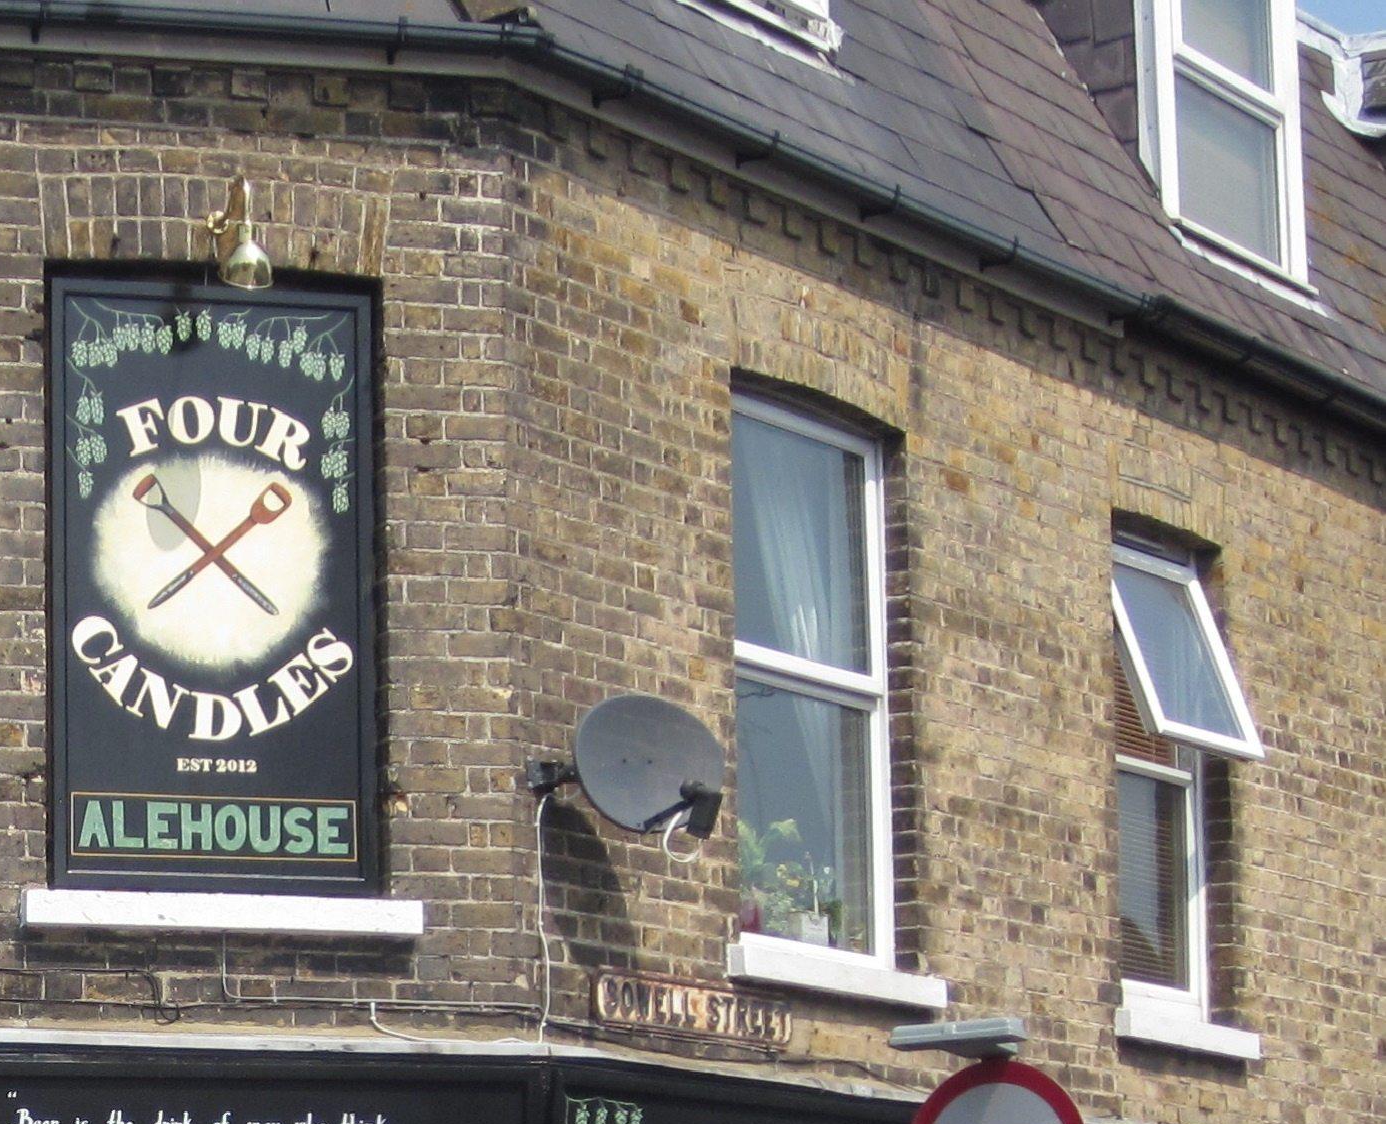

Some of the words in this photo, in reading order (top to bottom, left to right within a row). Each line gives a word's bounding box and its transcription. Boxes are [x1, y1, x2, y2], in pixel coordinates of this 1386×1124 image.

[115, 395, 310, 472] FOUR
[71, 614, 354, 742] CANDLES
[176, 757, 214, 773] EST
[215, 758, 258, 774] 2012
[77, 800, 350, 856] ALEHOUSE
[705, 993, 792, 1044] STREET
